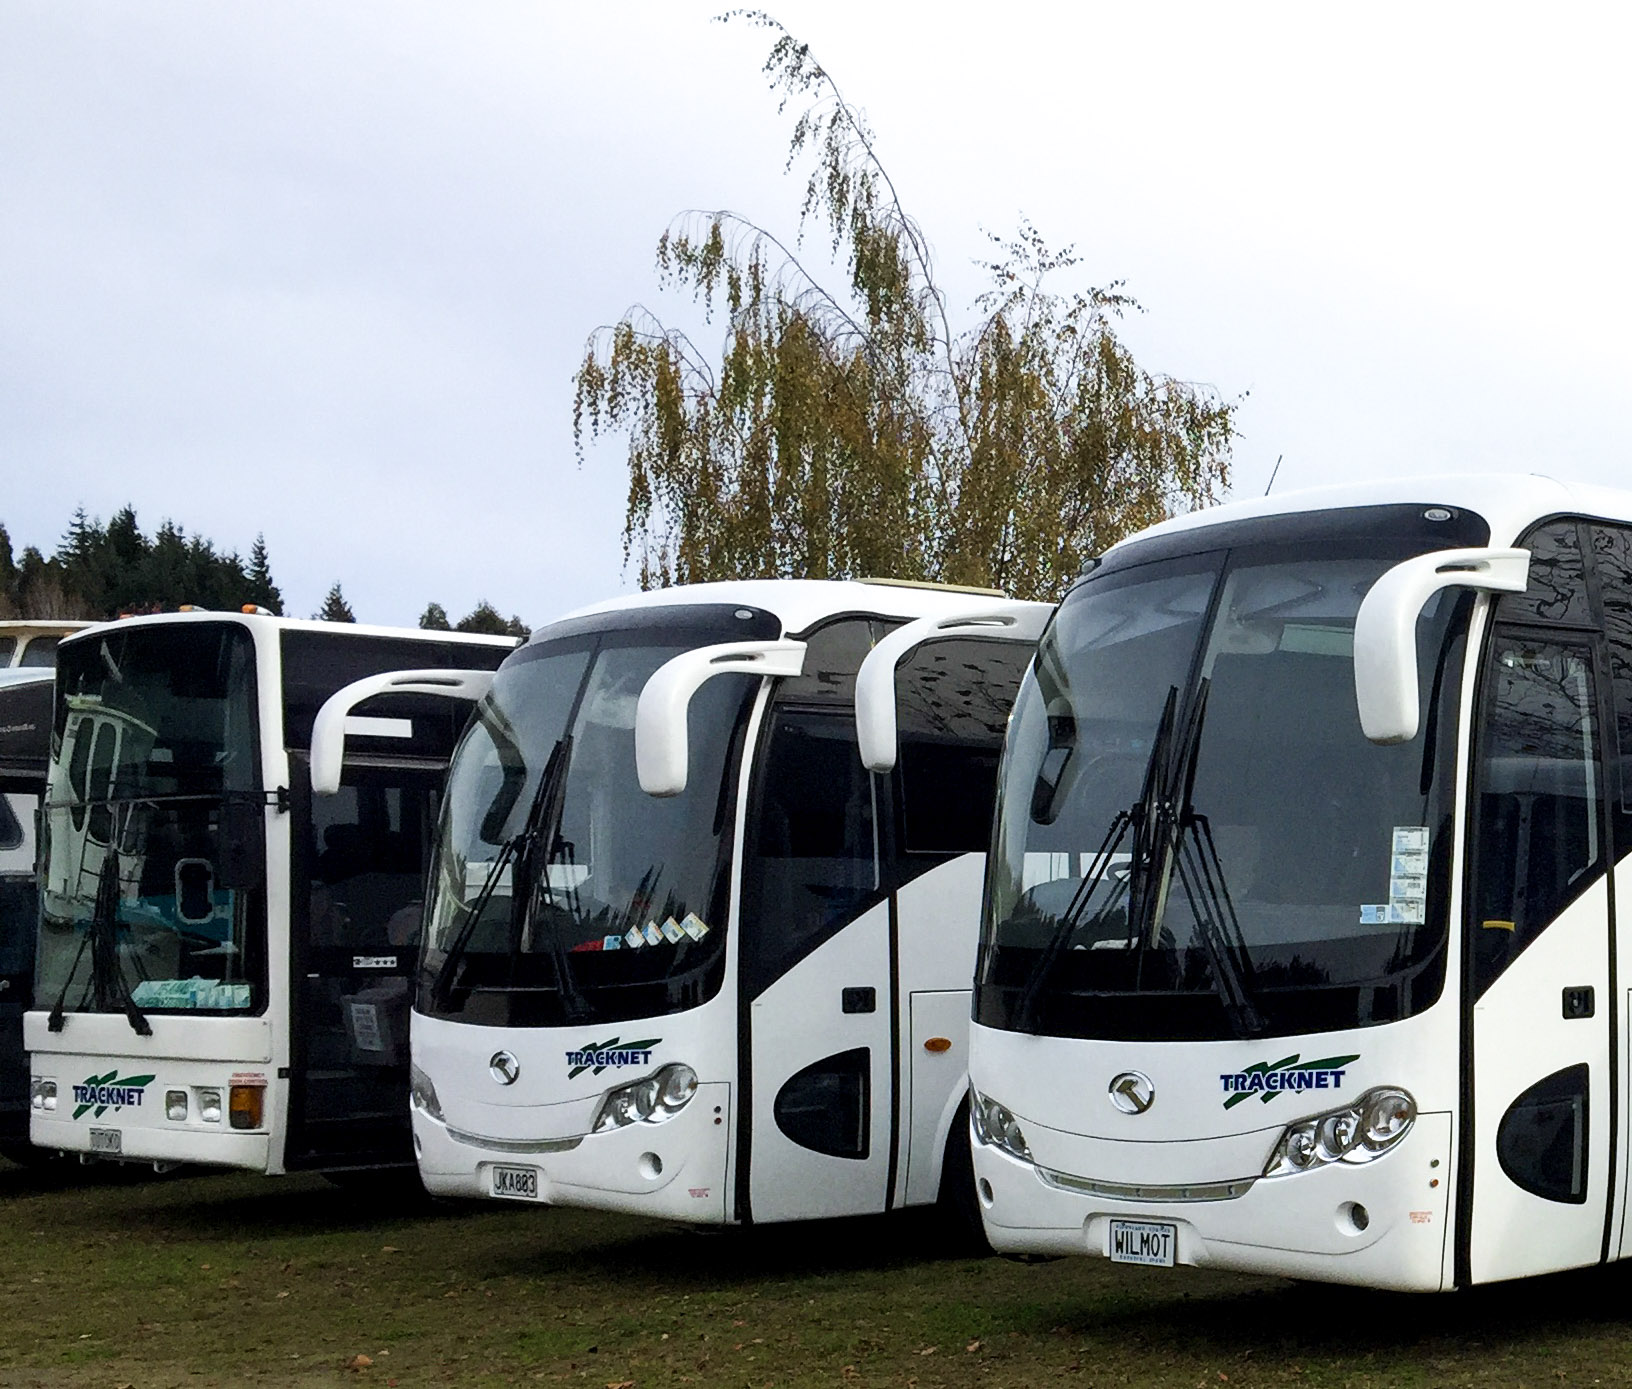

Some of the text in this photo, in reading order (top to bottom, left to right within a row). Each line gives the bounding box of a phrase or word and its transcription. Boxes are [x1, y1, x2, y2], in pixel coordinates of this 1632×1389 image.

[565, 1050, 652, 1066] TRACKNET
[1220, 1070, 1346, 1091] TRACKNET
[72, 1085, 145, 1106] TRACKNET
[1115, 1230, 1170, 1258] WILMOT
